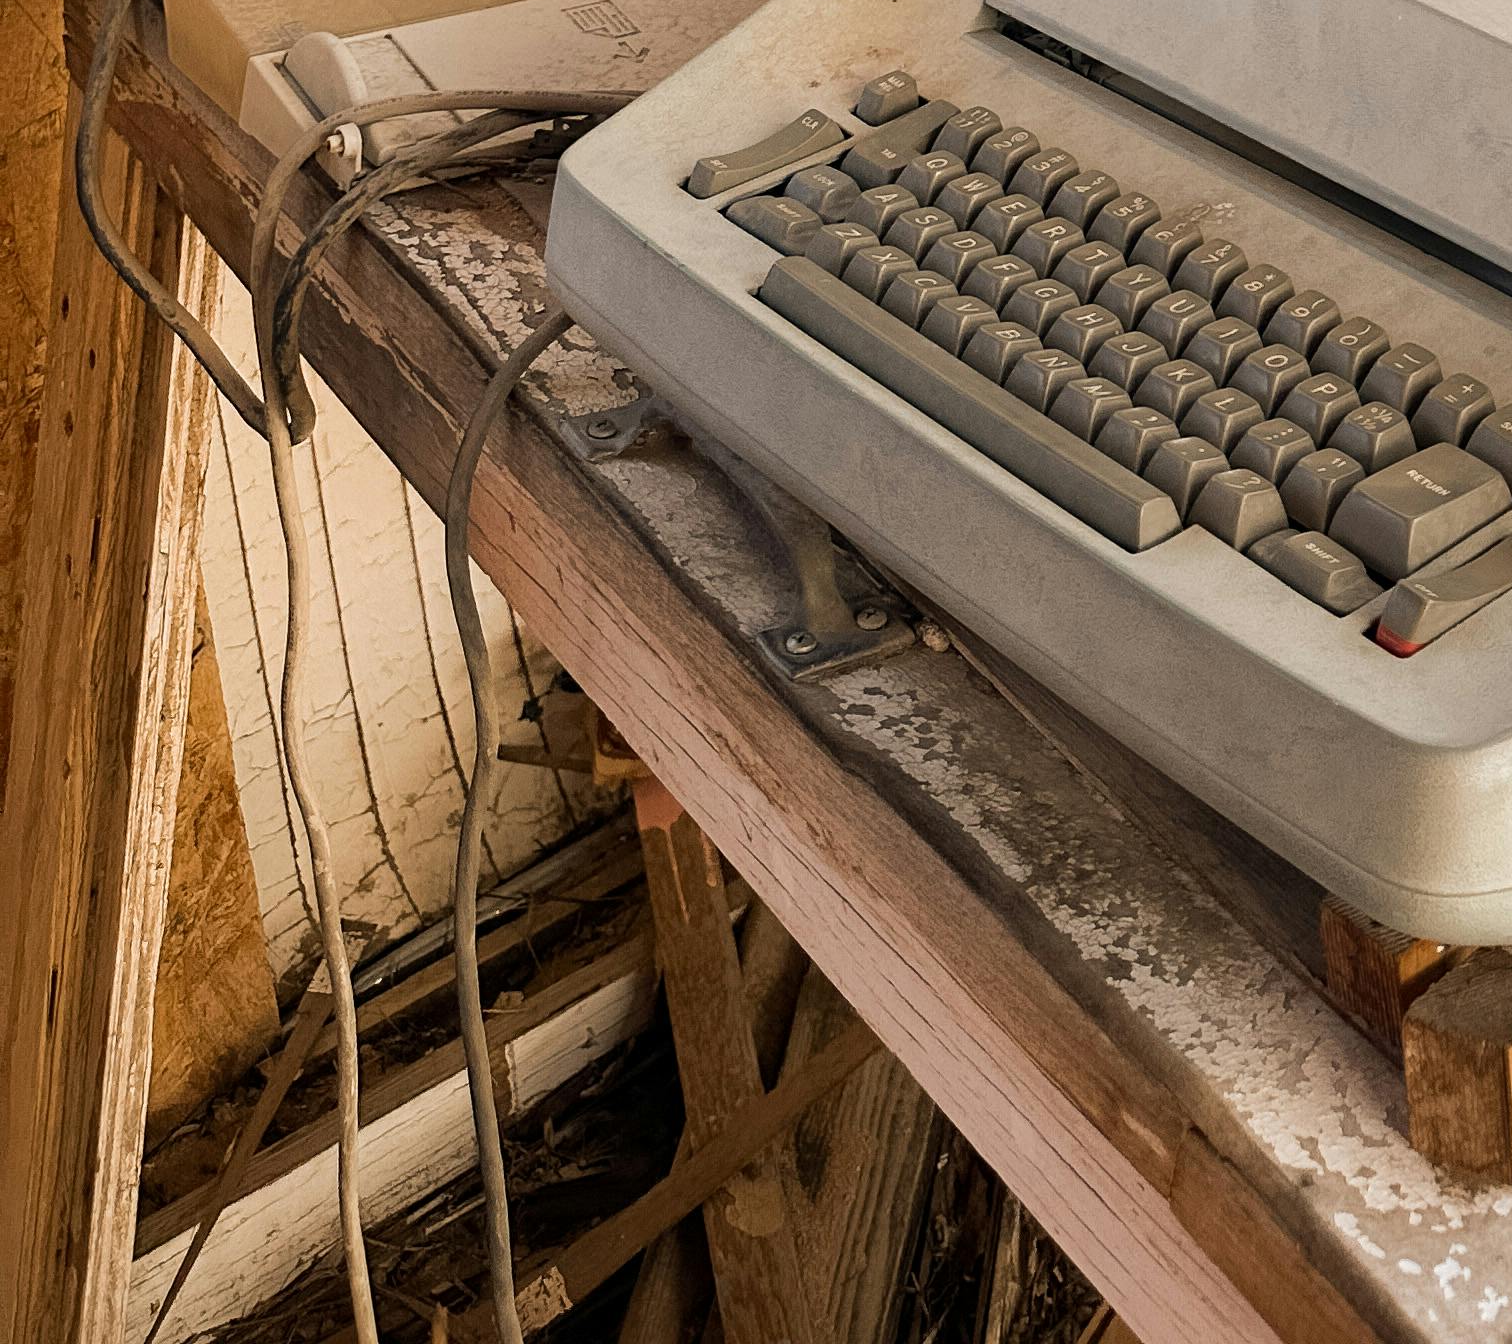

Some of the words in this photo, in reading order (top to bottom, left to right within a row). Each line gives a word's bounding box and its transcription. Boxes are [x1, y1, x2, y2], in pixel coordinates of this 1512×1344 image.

[802, 116, 819, 130] CLR
[993, 140, 1012, 150] 2
[926, 158, 948, 169] Q
[1032, 161, 1050, 172] 3
[963, 179, 989, 192] W
[1074, 184, 1092, 193] 4
[874, 193, 899, 203] A
[1001, 201, 1027, 214] E
[1113, 206, 1134, 217] 5
[915, 215, 938, 225] S
[835, 228, 862, 238] Z
[1042, 223, 1067, 238] R
[1155, 230, 1174, 242] 6
[953, 238, 977, 249] D
[871, 252, 899, 263] X
[1085, 248, 1109, 261] T
[1200, 254, 1219, 265] 7
[993, 262, 1020, 271] F
[914, 277, 937, 287] C
[1128, 272, 1152, 286] Y
[1244, 280, 1265, 292] 8
[1034, 287, 1059, 298] G
[956, 302, 980, 313] V
[1169, 299, 1196, 313] U
[1291, 306, 1311, 318] 9
[1076, 312, 1104, 326] H
[995, 329, 1021, 339] B
[1218, 328, 1239, 339] I
[1122, 343, 1148, 353] J
[1038, 356, 1068, 369] N
[1264, 354, 1289, 368] O
[1167, 367, 1195, 382] K
[1082, 384, 1113, 396] M
[1311, 382, 1338, 395] P
[1215, 397, 1235, 411] L
[1405, 469, 1451, 497] RETURN
[1304, 541, 1341, 564] SHIFT
[1414, 583, 1440, 599] OFF
